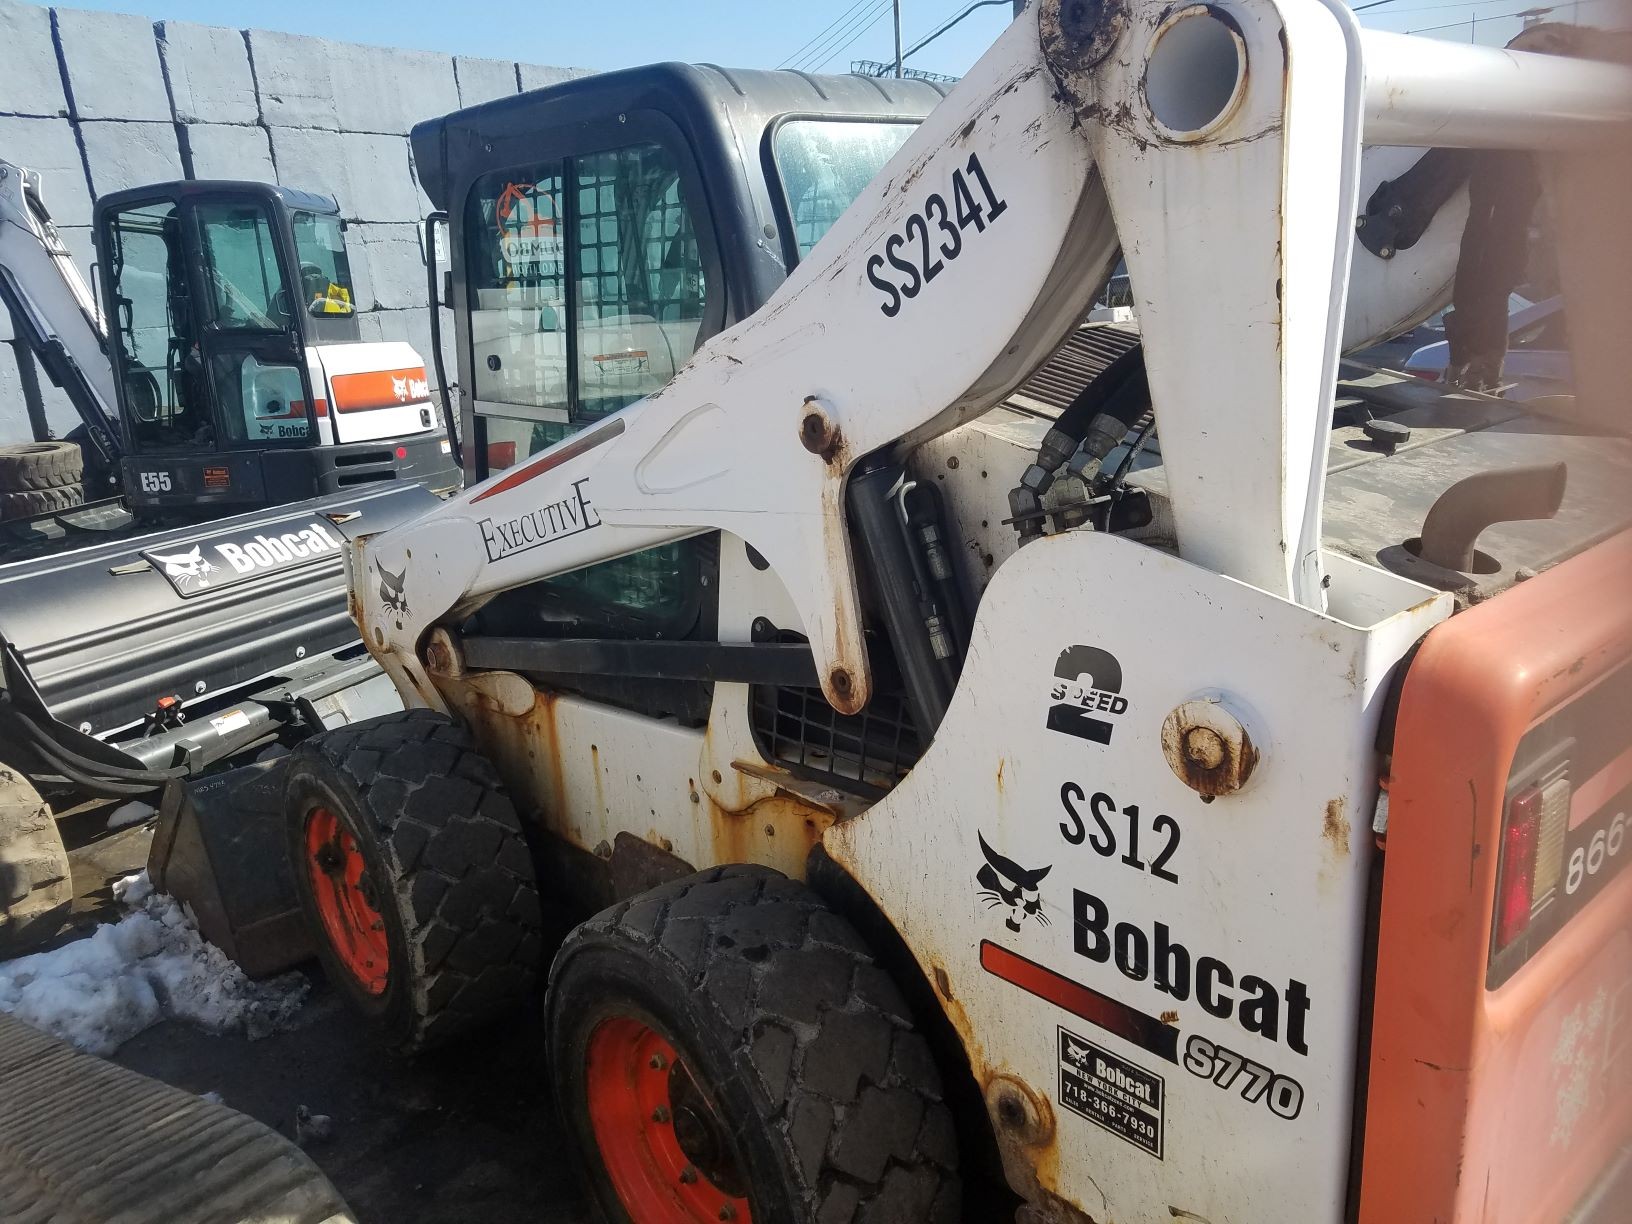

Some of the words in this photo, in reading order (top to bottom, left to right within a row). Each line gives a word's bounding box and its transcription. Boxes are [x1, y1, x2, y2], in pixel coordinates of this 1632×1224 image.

[866, 151, 1008, 318] SS2341
[140, 471, 172, 492] E55
[214, 523, 341, 574] Bobcat
[1059, 781, 1181, 885] SS12
[1073, 887, 1311, 1057] Bobcat
[1076, 1068, 1093, 1083] NEW
[1097, 1079, 1119, 1097] YORK
[1122, 1092, 1142, 1109] CITY
[1095, 1057, 1151, 1102] Bobcat
[1183, 1034, 1305, 1121] S770
[1064, 1080, 1155, 1139] 718-366-7930
